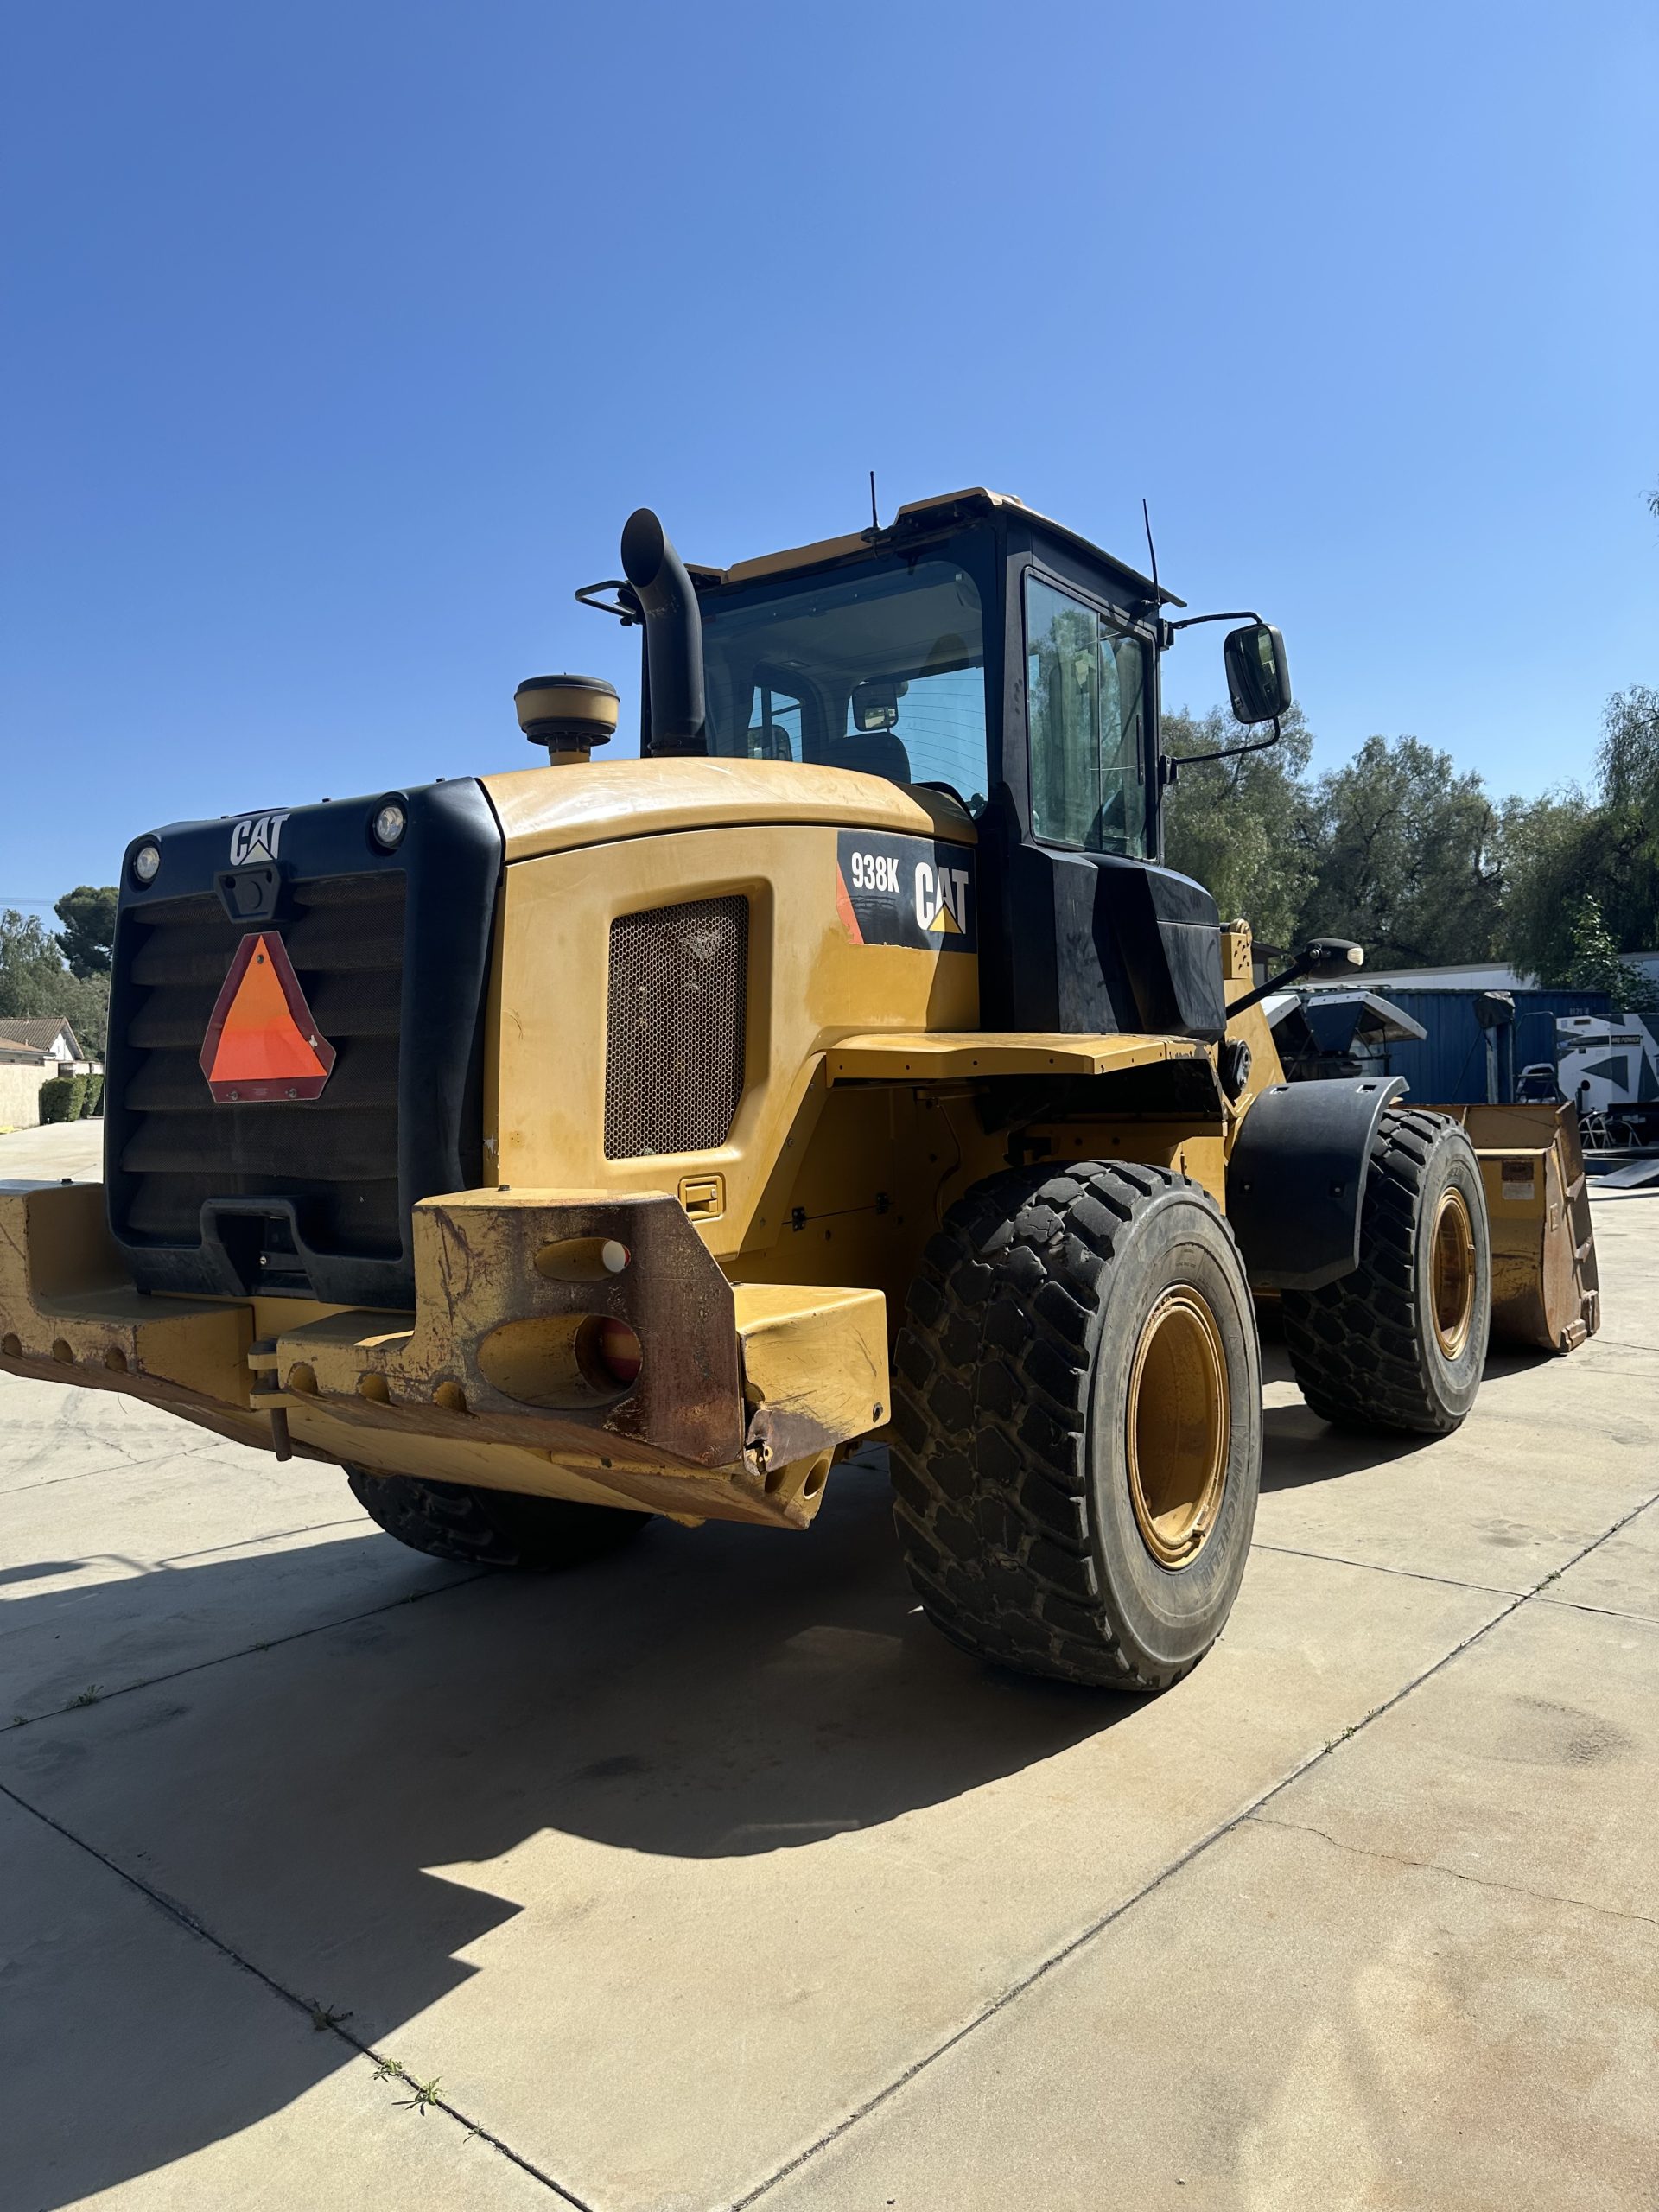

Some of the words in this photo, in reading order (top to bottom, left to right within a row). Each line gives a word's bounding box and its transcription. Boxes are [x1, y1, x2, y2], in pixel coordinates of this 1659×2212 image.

[230, 814, 290, 866] CAT
[851, 852, 900, 893] 938K
[914, 862, 969, 934] CAT
